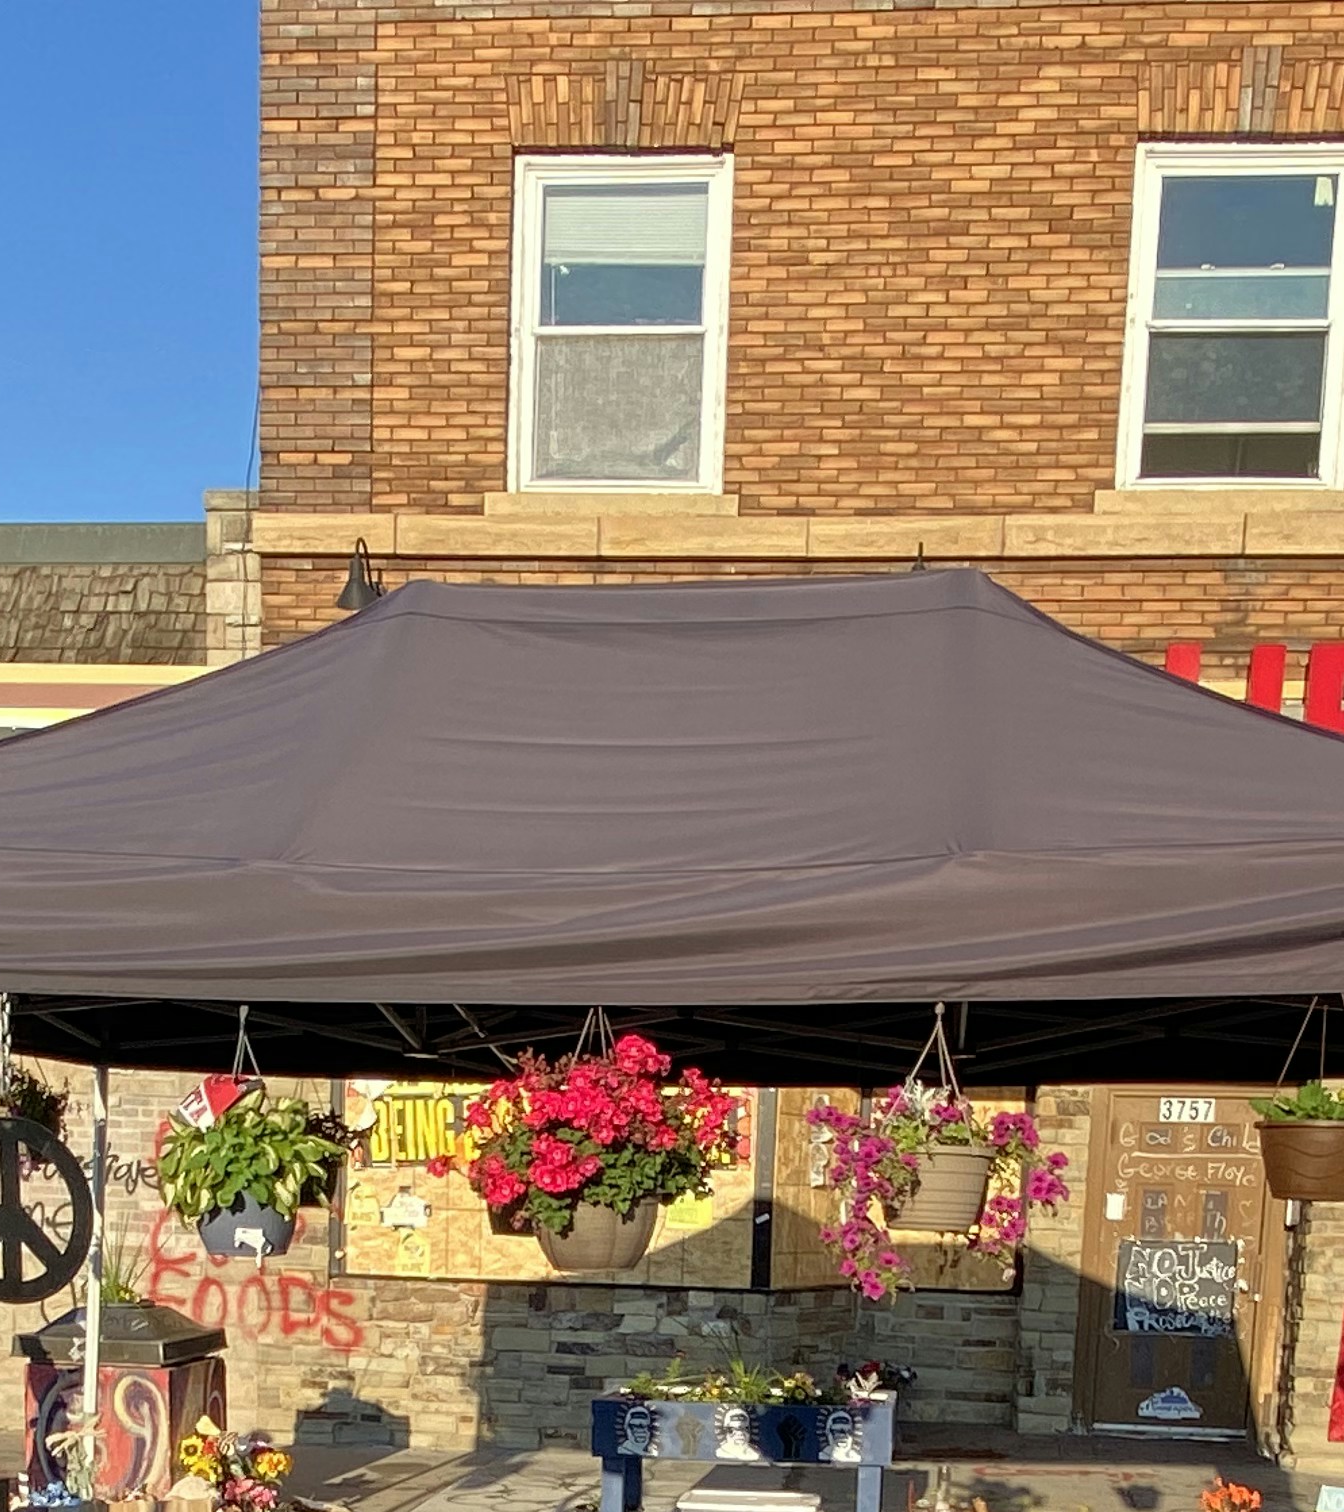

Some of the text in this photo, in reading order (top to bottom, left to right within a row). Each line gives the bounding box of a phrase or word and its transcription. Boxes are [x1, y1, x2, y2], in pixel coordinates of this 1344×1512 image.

[1162, 1100, 1213, 1121] 3757
[372, 1099, 456, 1163] BEING
[1117, 1153, 1200, 1181] George
